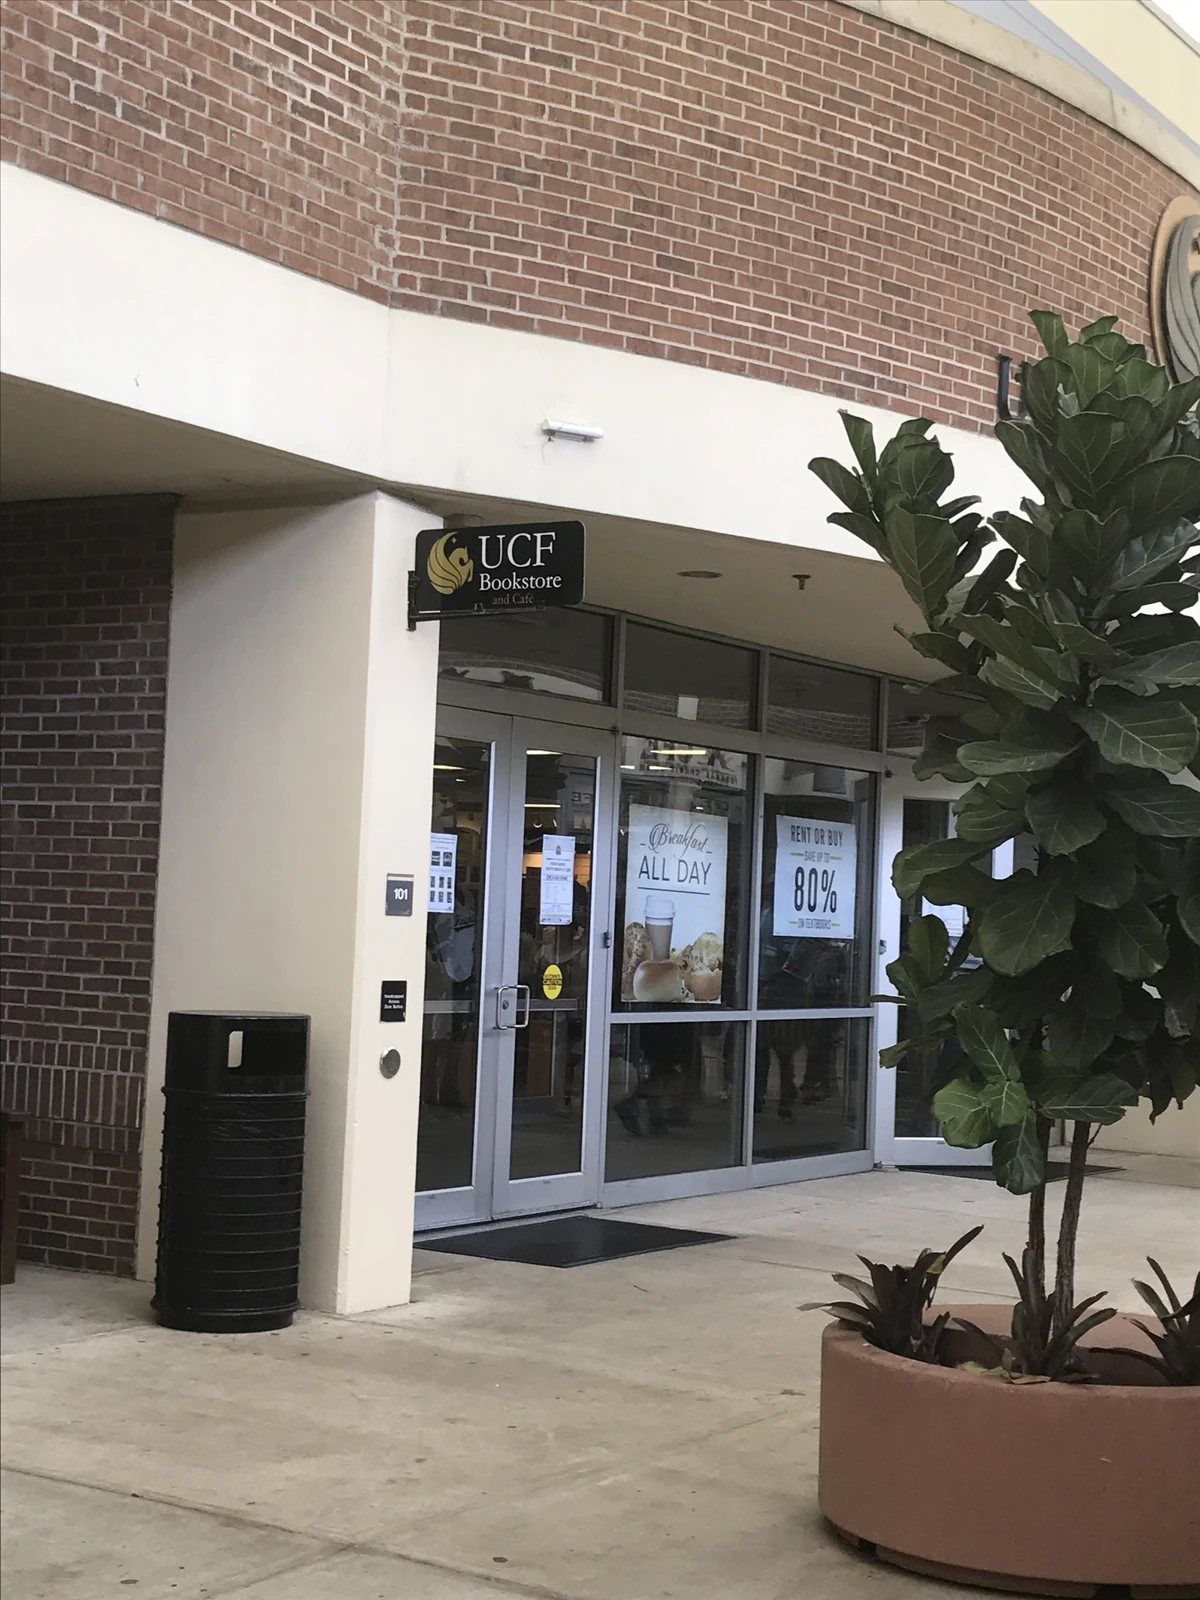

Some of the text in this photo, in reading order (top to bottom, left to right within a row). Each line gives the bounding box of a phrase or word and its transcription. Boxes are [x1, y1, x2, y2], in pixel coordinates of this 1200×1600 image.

[478, 531, 556, 569] UCF
[479, 572, 562, 591] Bookstore
[492, 594, 509, 606] and
[648, 822, 709, 860] Breakfast
[790, 824, 843, 847] RENT OR BUY
[638, 854, 712, 885] ALL DAY
[393, 888, 408, 900] 101
[794, 866, 837, 913] 80%
